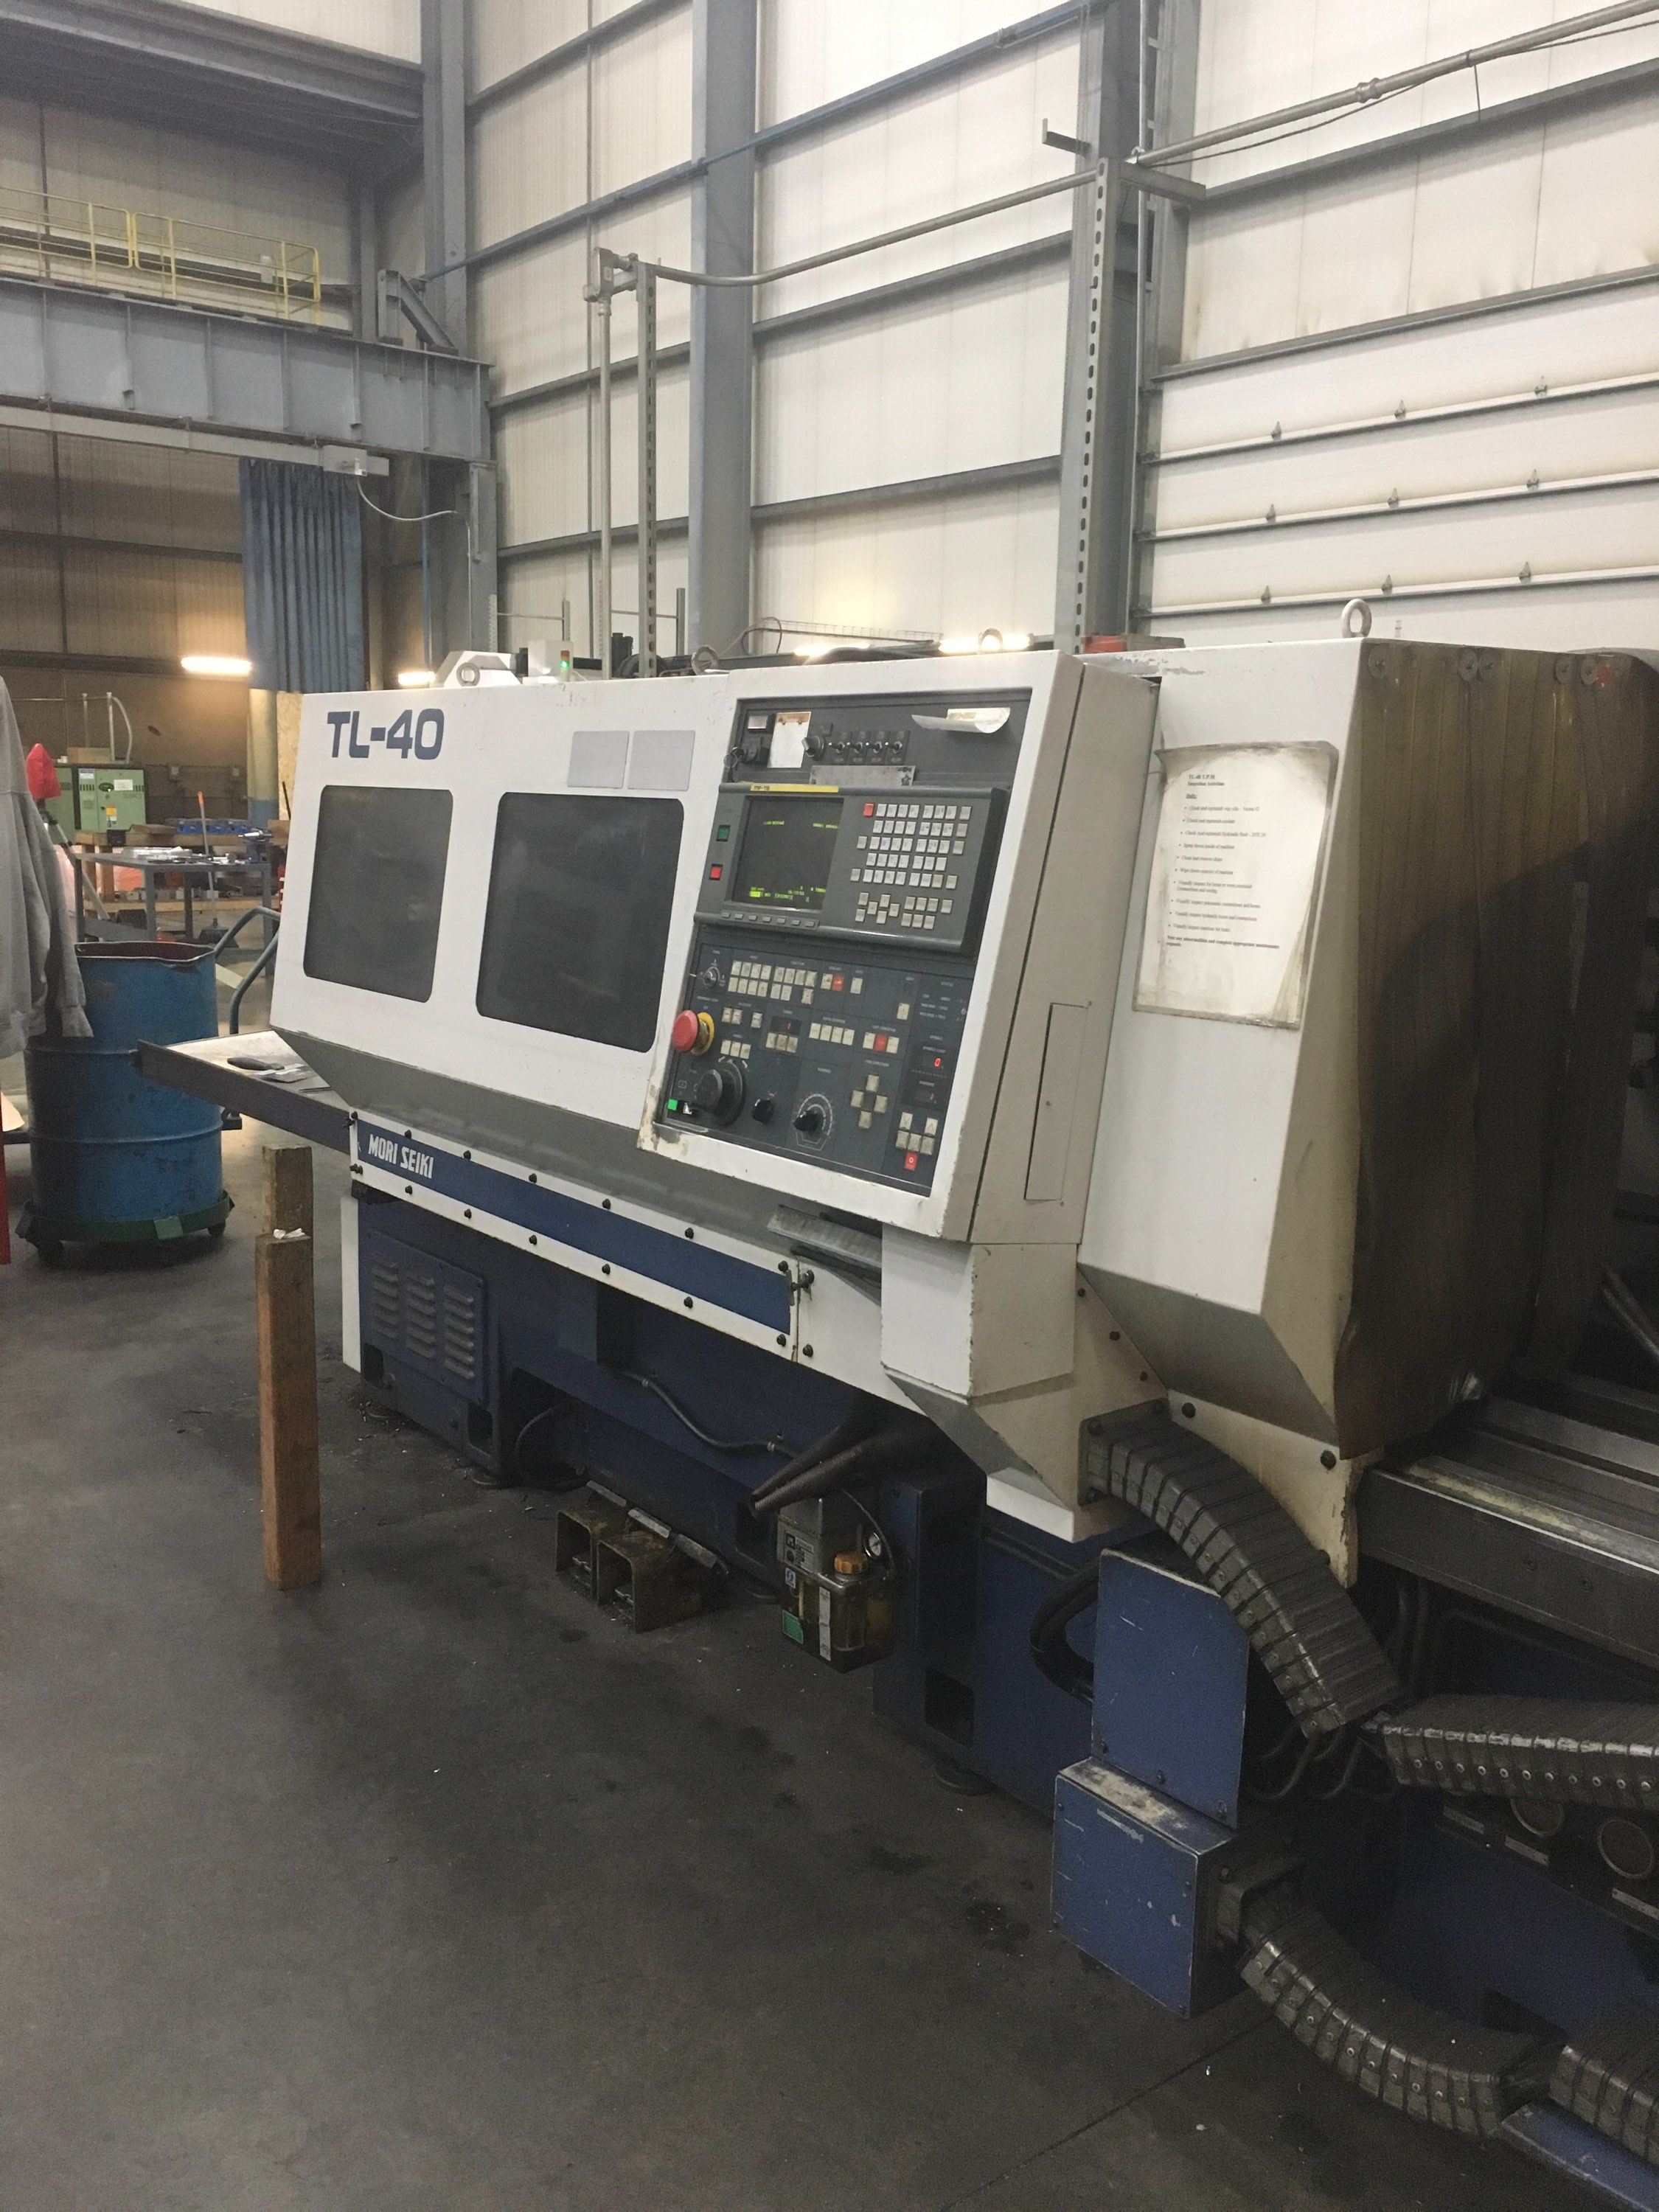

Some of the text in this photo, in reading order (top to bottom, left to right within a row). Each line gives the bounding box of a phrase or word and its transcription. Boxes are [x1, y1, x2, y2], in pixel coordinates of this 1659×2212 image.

[327, 708, 445, 760] TL-40
[368, 1133, 434, 1179] MORI SEIKI
